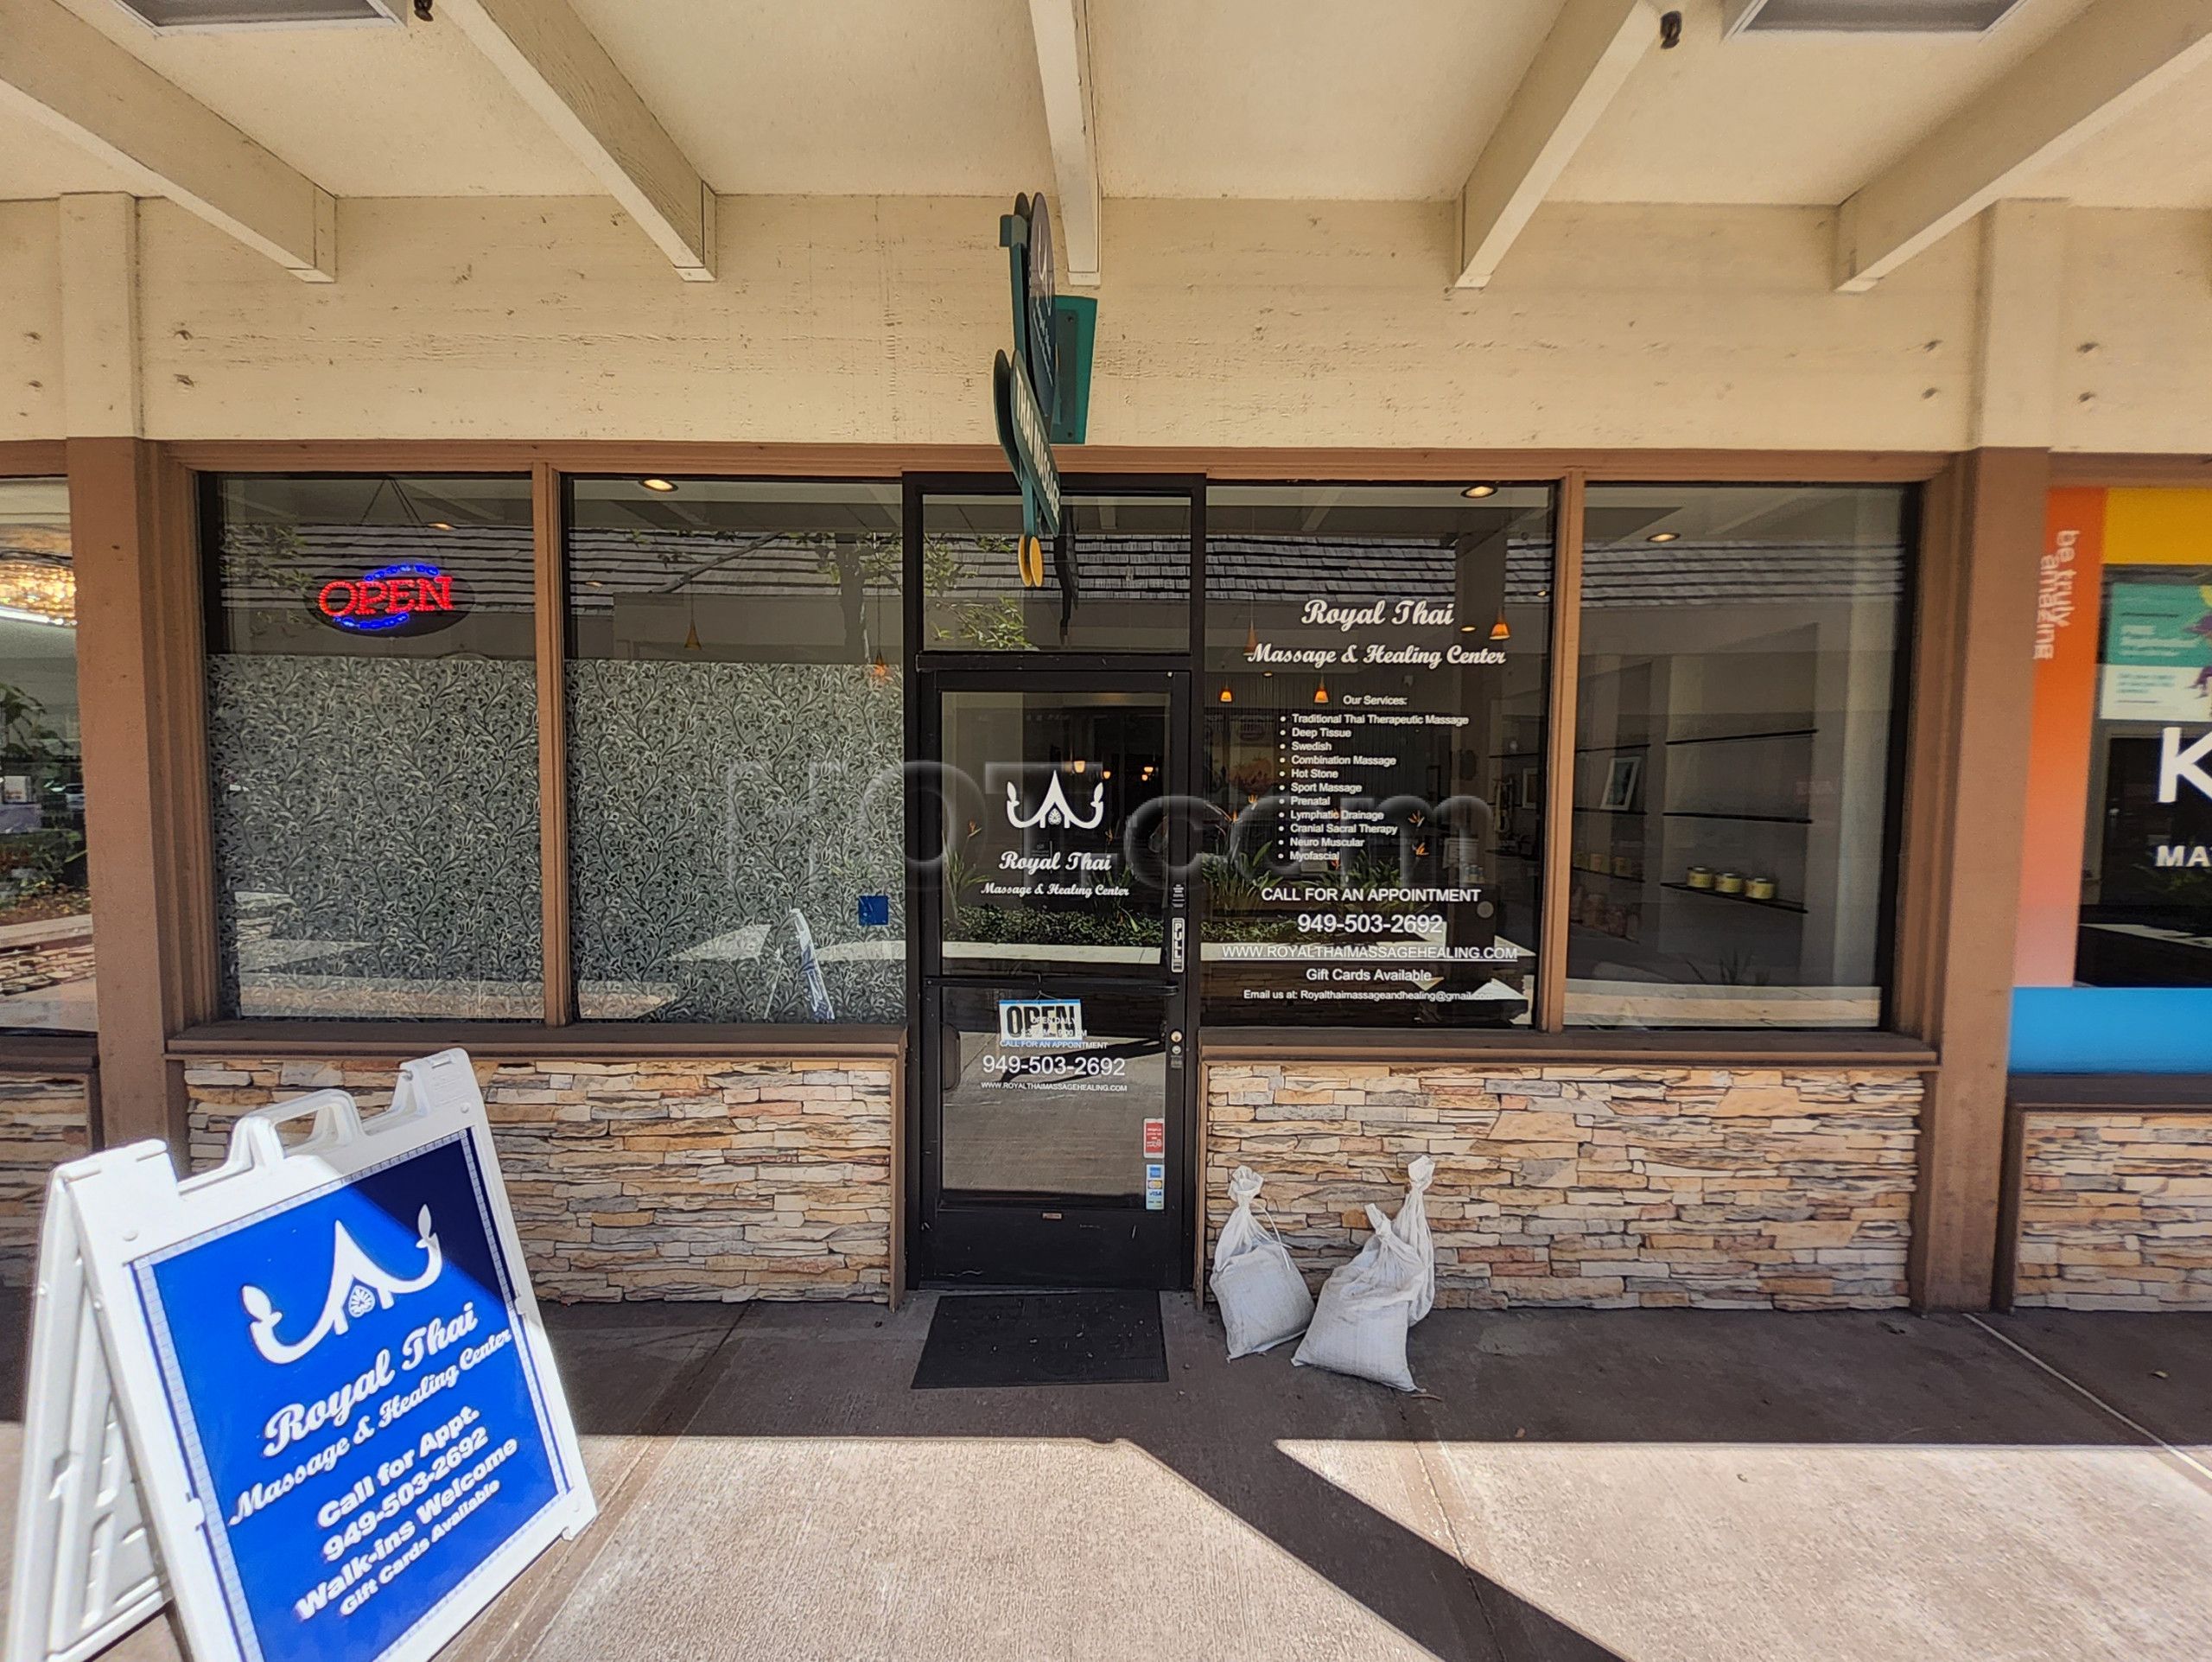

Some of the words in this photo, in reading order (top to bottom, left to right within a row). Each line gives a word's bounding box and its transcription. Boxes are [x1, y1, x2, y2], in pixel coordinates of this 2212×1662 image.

[2056, 530, 2081, 562] be
[318, 576, 454, 616] OPEN
[2049, 570, 2076, 627] truly
[1300, 599, 1386, 632] Royal
[1390, 599, 1454, 625] Thai
[1247, 643, 1336, 668] Massage
[1341, 644, 1358, 664] &
[1363, 645, 1442, 669] Healing
[1446, 645, 1506, 665] Center
[1343, 695, 1362, 705] Our
[1363, 695, 1408, 705] Services:
[1292, 714, 1342, 724] Traditional
[1344, 715, 1365, 725] Thai
[1368, 715, 1423, 727] Therapeutic
[1425, 716, 1469, 726] Massage
[1292, 728, 1318, 739] Deep
[1320, 728, 1351, 738] Tissue
[1291, 742, 1332, 751] Swedish
[1291, 755, 1351, 765] Combination
[1353, 755, 1396, 767] Massage
[1291, 769, 1308, 779] Hot
[1311, 769, 1338, 779] Stone
[1291, 783, 1317, 793] Sport
[1319, 783, 1362, 793] Massage
[1290, 796, 1331, 806] Prenatal
[1290, 810, 1339, 821] Lymphatic
[1341, 810, 1383, 821] Drainage
[1290, 824, 1324, 833] Cranial
[1325, 824, 1357, 833] Sacral
[1359, 824, 1397, 835] Therapy
[1290, 837, 1319, 847] Neuro
[1321, 837, 1365, 847] Muscular
[998, 850, 1061, 875] Royal
[1065, 852, 1112, 871] Thai
[1290, 851, 1339, 862] Myofascial
[2157, 844, 2212, 867] MA
[981, 882, 1032, 895] Massage
[1036, 883, 1045, 894] &
[1046, 883, 1092, 898] Healing
[1094, 884, 1129, 896] Center
[1262, 888, 1300, 901] CALL
[1305, 888, 1338, 901] FOR
[1341, 888, 1364, 901] AN
[1370, 888, 1481, 901] APPOINTMENT
[1297, 914, 1443, 933] 949-503-2692
[1222, 946, 1518, 960] WWW.ROYALTHAIMASSAGEHEALING.COM
[1306, 970, 1331, 981] Gift
[1332, 970, 1371, 980] Cards
[1373, 970, 1432, 981] Available
[1243, 990, 1270, 999] Email
[1287, 990, 1298, 999] at:
[1006, 1005, 1075, 1037] OPEN
[1052, 1041, 1109, 1049] APPOINTMENT
[982, 1054, 1126, 1077] 949-503-2692
[263, 1348, 397, 1459] Royal
[402, 1302, 479, 1372] Thai
[228, 1436, 351, 1526] Massage
[353, 1416, 375, 1444] &
[378, 1365, 460, 1430] Healing
[459, 1328, 512, 1372] Center
[317, 1476, 374, 1528] Call
[377, 1449, 416, 1487] for
[419, 1405, 480, 1460] Appt.
[321, 1426, 489, 1561] 949-503-2692
[294, 1521, 416, 1621] Walk-ins
[416, 1437, 518, 1525] Welcome
[340, 1581, 378, 1616] Gift
[378, 1539, 430, 1585] Cards
[431, 1480, 501, 1544] Available
